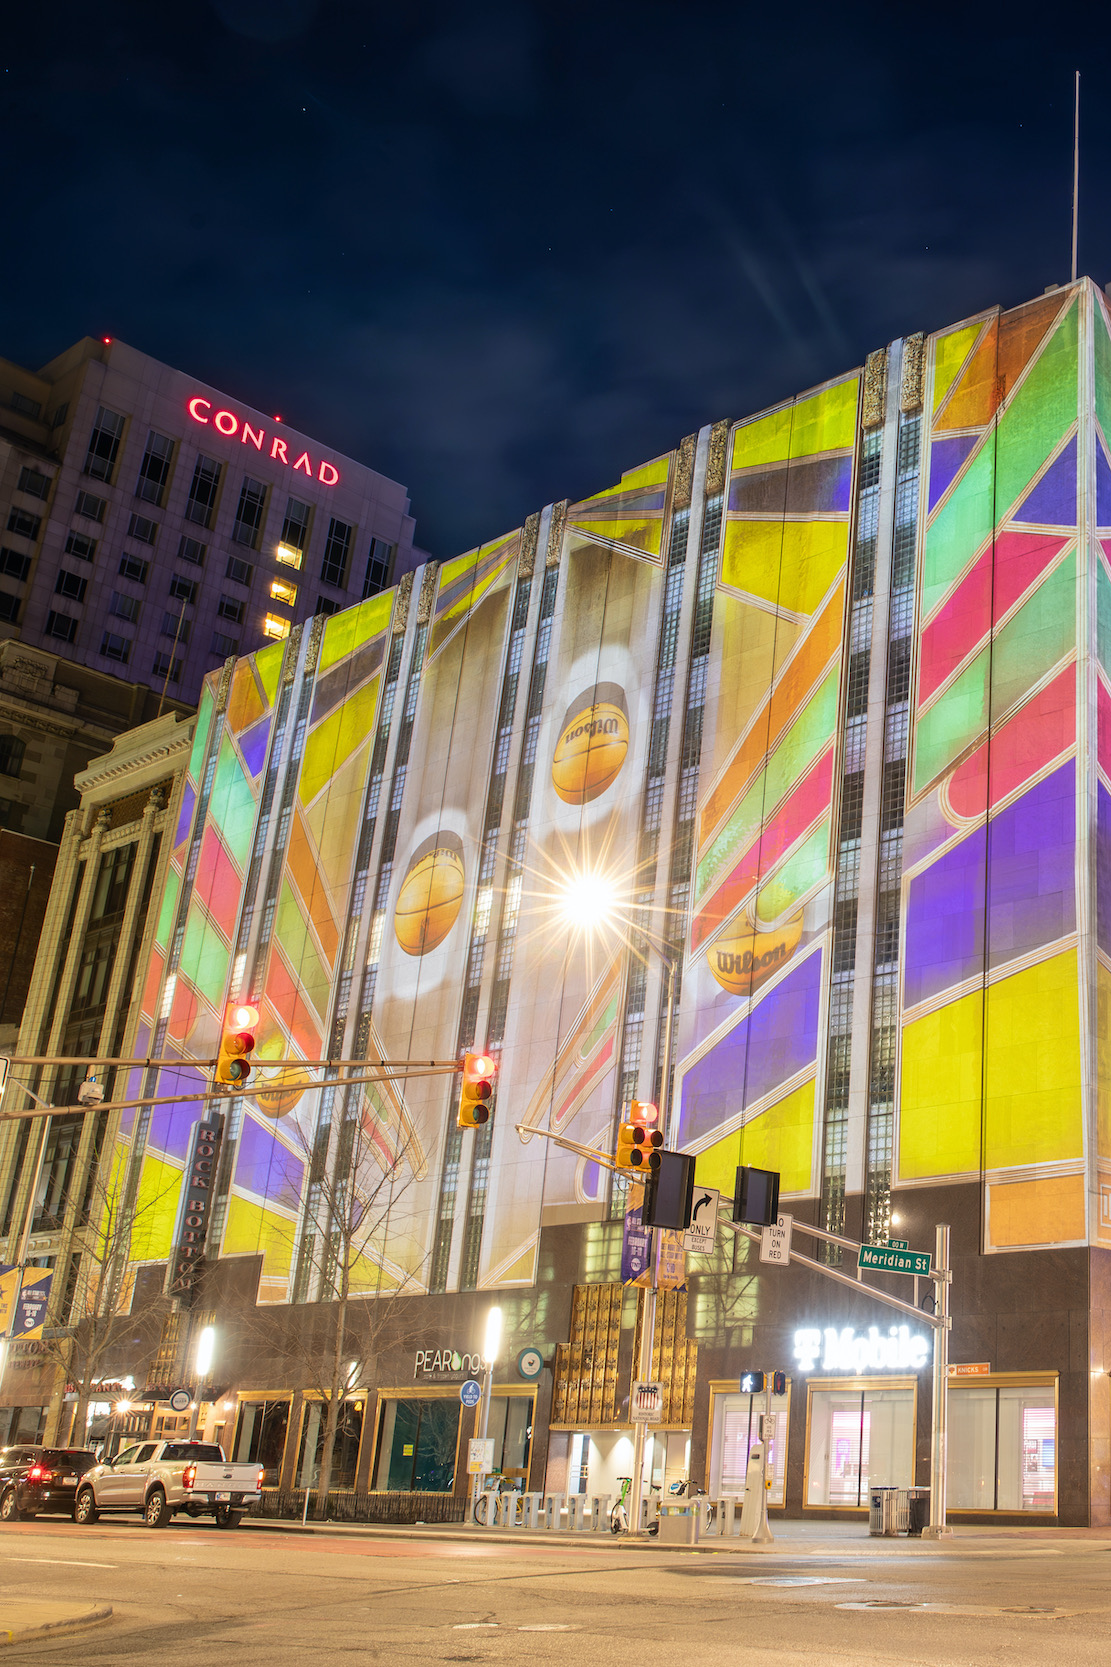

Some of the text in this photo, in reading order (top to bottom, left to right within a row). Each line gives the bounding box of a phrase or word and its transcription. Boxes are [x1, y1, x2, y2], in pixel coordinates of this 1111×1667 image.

[188, 397, 340, 487] CONRAD
[565, 718, 619, 744] Wilson
[716, 942, 786, 975] Wilson
[175, 1129, 217, 1289] ROCK BOTTOM
[690, 1224, 711, 1236] ONLY
[769, 1228, 785, 1239] TURN
[768, 1250, 781, 1259] RED
[771, 1240, 781, 1248] ON
[863, 1250, 927, 1271] Meridian St
[823, 1325, 929, 1371] Mobile
[957, 1366, 979, 1374] KNICKS
